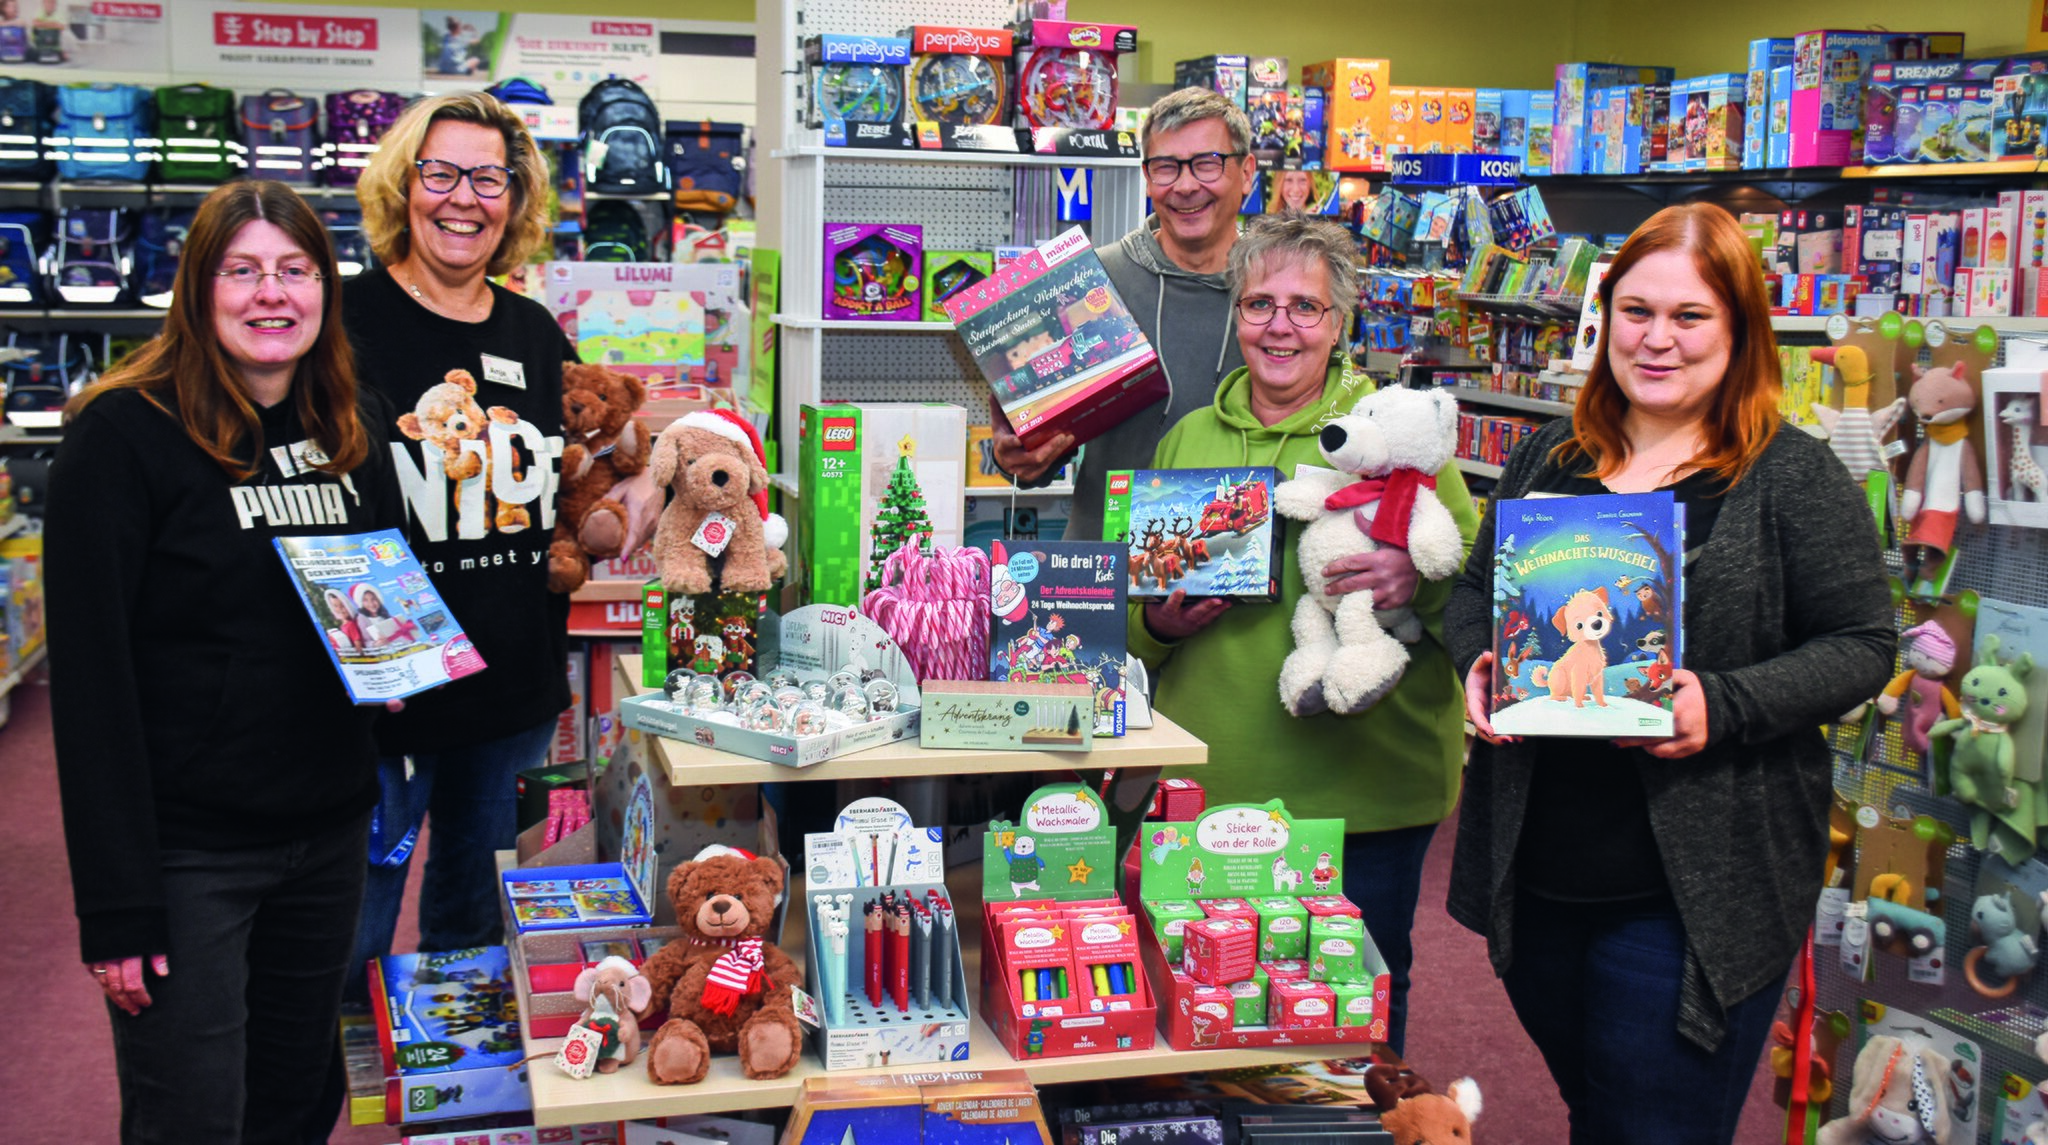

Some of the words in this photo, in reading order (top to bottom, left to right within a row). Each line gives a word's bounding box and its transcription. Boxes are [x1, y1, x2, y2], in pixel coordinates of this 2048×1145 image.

[252, 18, 293, 45] Step
[297, 20, 320, 47] by
[325, 22, 365, 48] Step
[923, 29, 1000, 54] perplexus
[1826, 35, 1881, 47] playmobil
[826, 38, 906, 63] perplexus
[856, 123, 892, 139] REBEL
[1069, 133, 1109, 150] PORTAL
[2027, 195, 2044, 204] goki
[834, 297, 872, 312] ADDICT
[874, 301, 883, 312] A
[885, 298, 912, 311] BALL
[968, 304, 1030, 345] Startpackung
[1033, 268, 1094, 304] Weihnachten
[975, 333, 1010, 356] Christmas
[1012, 317, 1036, 336] Starter
[1039, 307, 1051, 318] Set
[824, 427, 854, 440] LEGO
[822, 457, 846, 470] 12+
[821, 471, 843, 479] 40573
[1111, 479, 1129, 489] LEGO
[229, 483, 349, 530] PUMA
[1108, 498, 1119, 507] 9+
[1574, 534, 1590, 544] DAS
[460, 549, 517, 570] meet
[1051, 554, 1069, 569] Die
[1070, 554, 1093, 569] drei
[1095, 554, 1117, 569] ???
[1514, 546, 1658, 577] WEIHNACHTSWUSCHEL
[1095, 569, 1115, 584] Kids
[1040, 585, 1054, 596] Der
[1055, 585, 1116, 597] Adventskalender
[1031, 600, 1039, 609] 24
[1040, 601, 1055, 611] Tage
[1056, 601, 1115, 612] Weihnachtsparade
[821, 610, 847, 626] NICI
[938, 704, 1013, 727] Adventskranz
[1115, 703, 1124, 734] KOSMOS
[770, 745, 787, 755] NICI
[1041, 805, 1081, 815] Metallic-
[1035, 817, 1090, 828] Wachsmaler
[1226, 822, 1262, 834] Sticker
[1211, 839, 1230, 849] von
[1232, 837, 1249, 848] der
[1252, 837, 1277, 849] Rolle
[1073, 1040, 1098, 1049] moses.
[903, 1073, 940, 1085] Harry
[941, 1071, 984, 1083] Potter
[937, 1100, 955, 1110] ADVENT
[1008, 1098, 1014, 1108] DE
[961, 1110, 989, 1120] CALENDARIO
[989, 1110, 996, 1119] DE
[997, 1109, 1019, 1119] ADVIENTO
[1074, 1109, 1090, 1123] Die
[1100, 1130, 1117, 1144] Die
